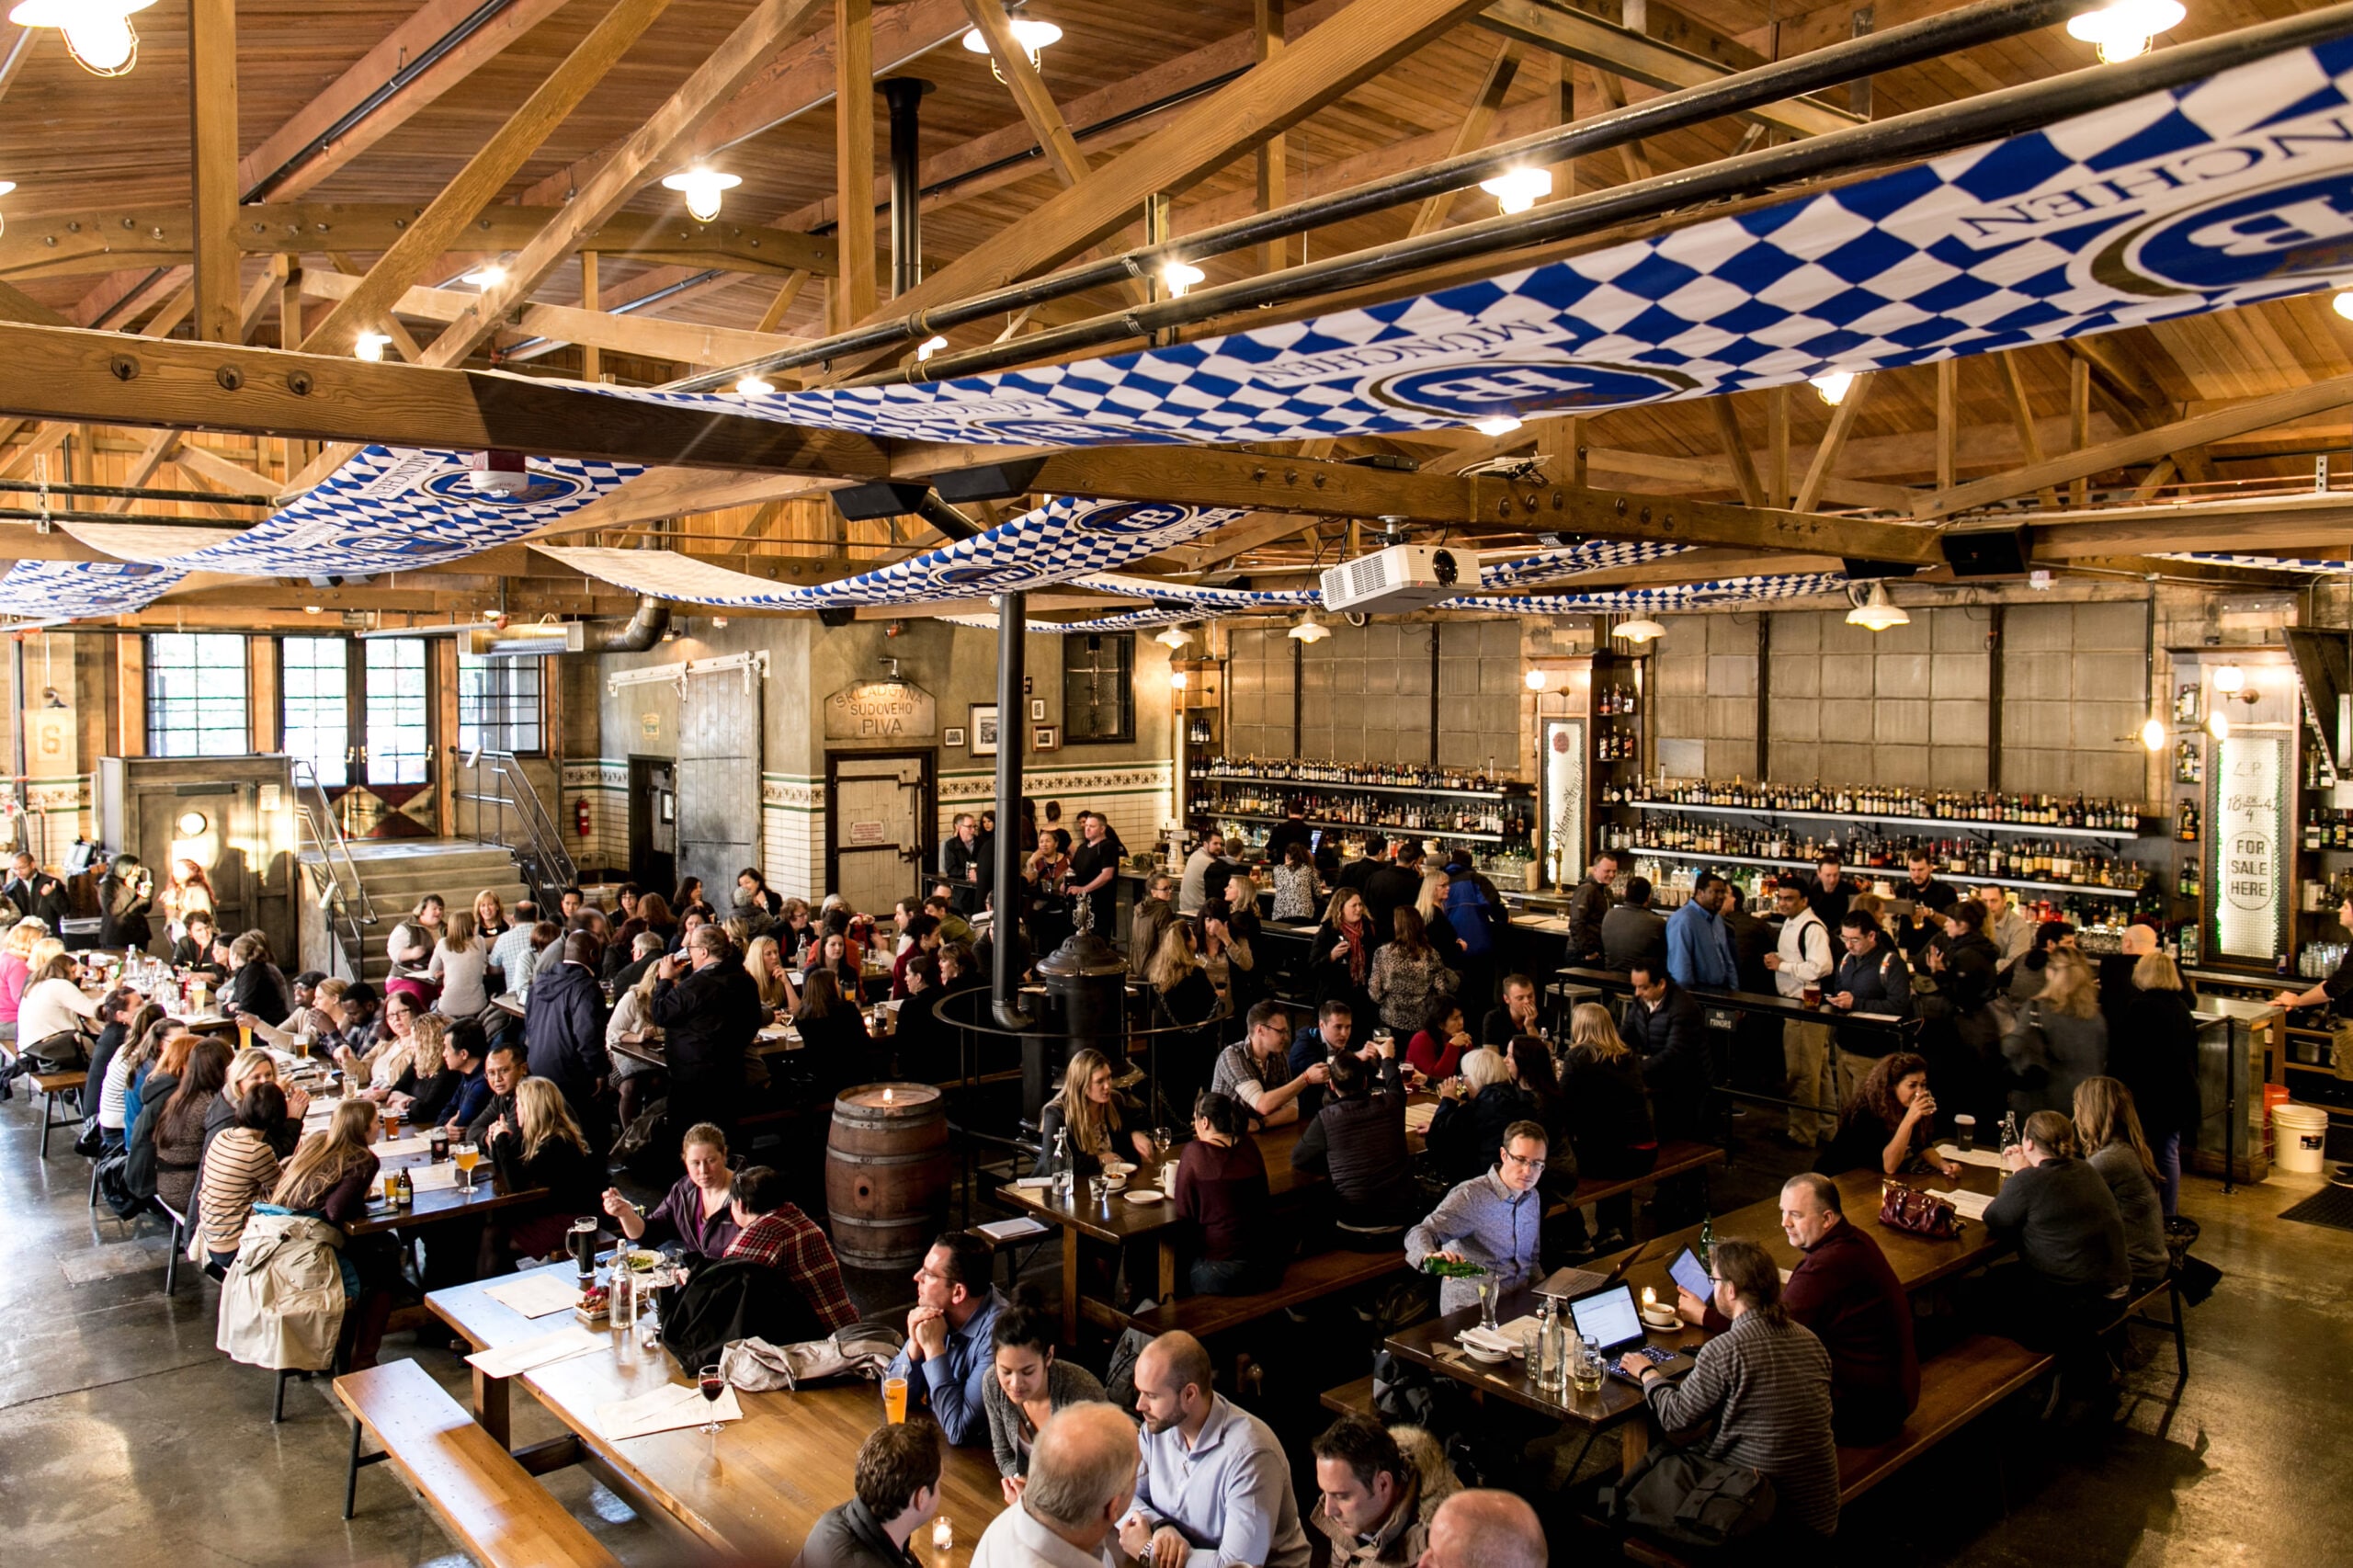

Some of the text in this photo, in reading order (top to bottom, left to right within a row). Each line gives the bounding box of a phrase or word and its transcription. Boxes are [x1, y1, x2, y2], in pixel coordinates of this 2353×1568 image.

[1959, 117, 2353, 239] NCHEN
[1246, 319, 1554, 382] MÜNCHEN
[1416, 369, 1594, 401] HB
[1118, 509, 1176, 530] HB
[862, 719, 904, 734] PIVA
[42, 725, 61, 754] 6
[2236, 840, 2265, 854] FOR
[2231, 860, 2268, 875] SALE
[2231, 881, 2268, 896] HERE
